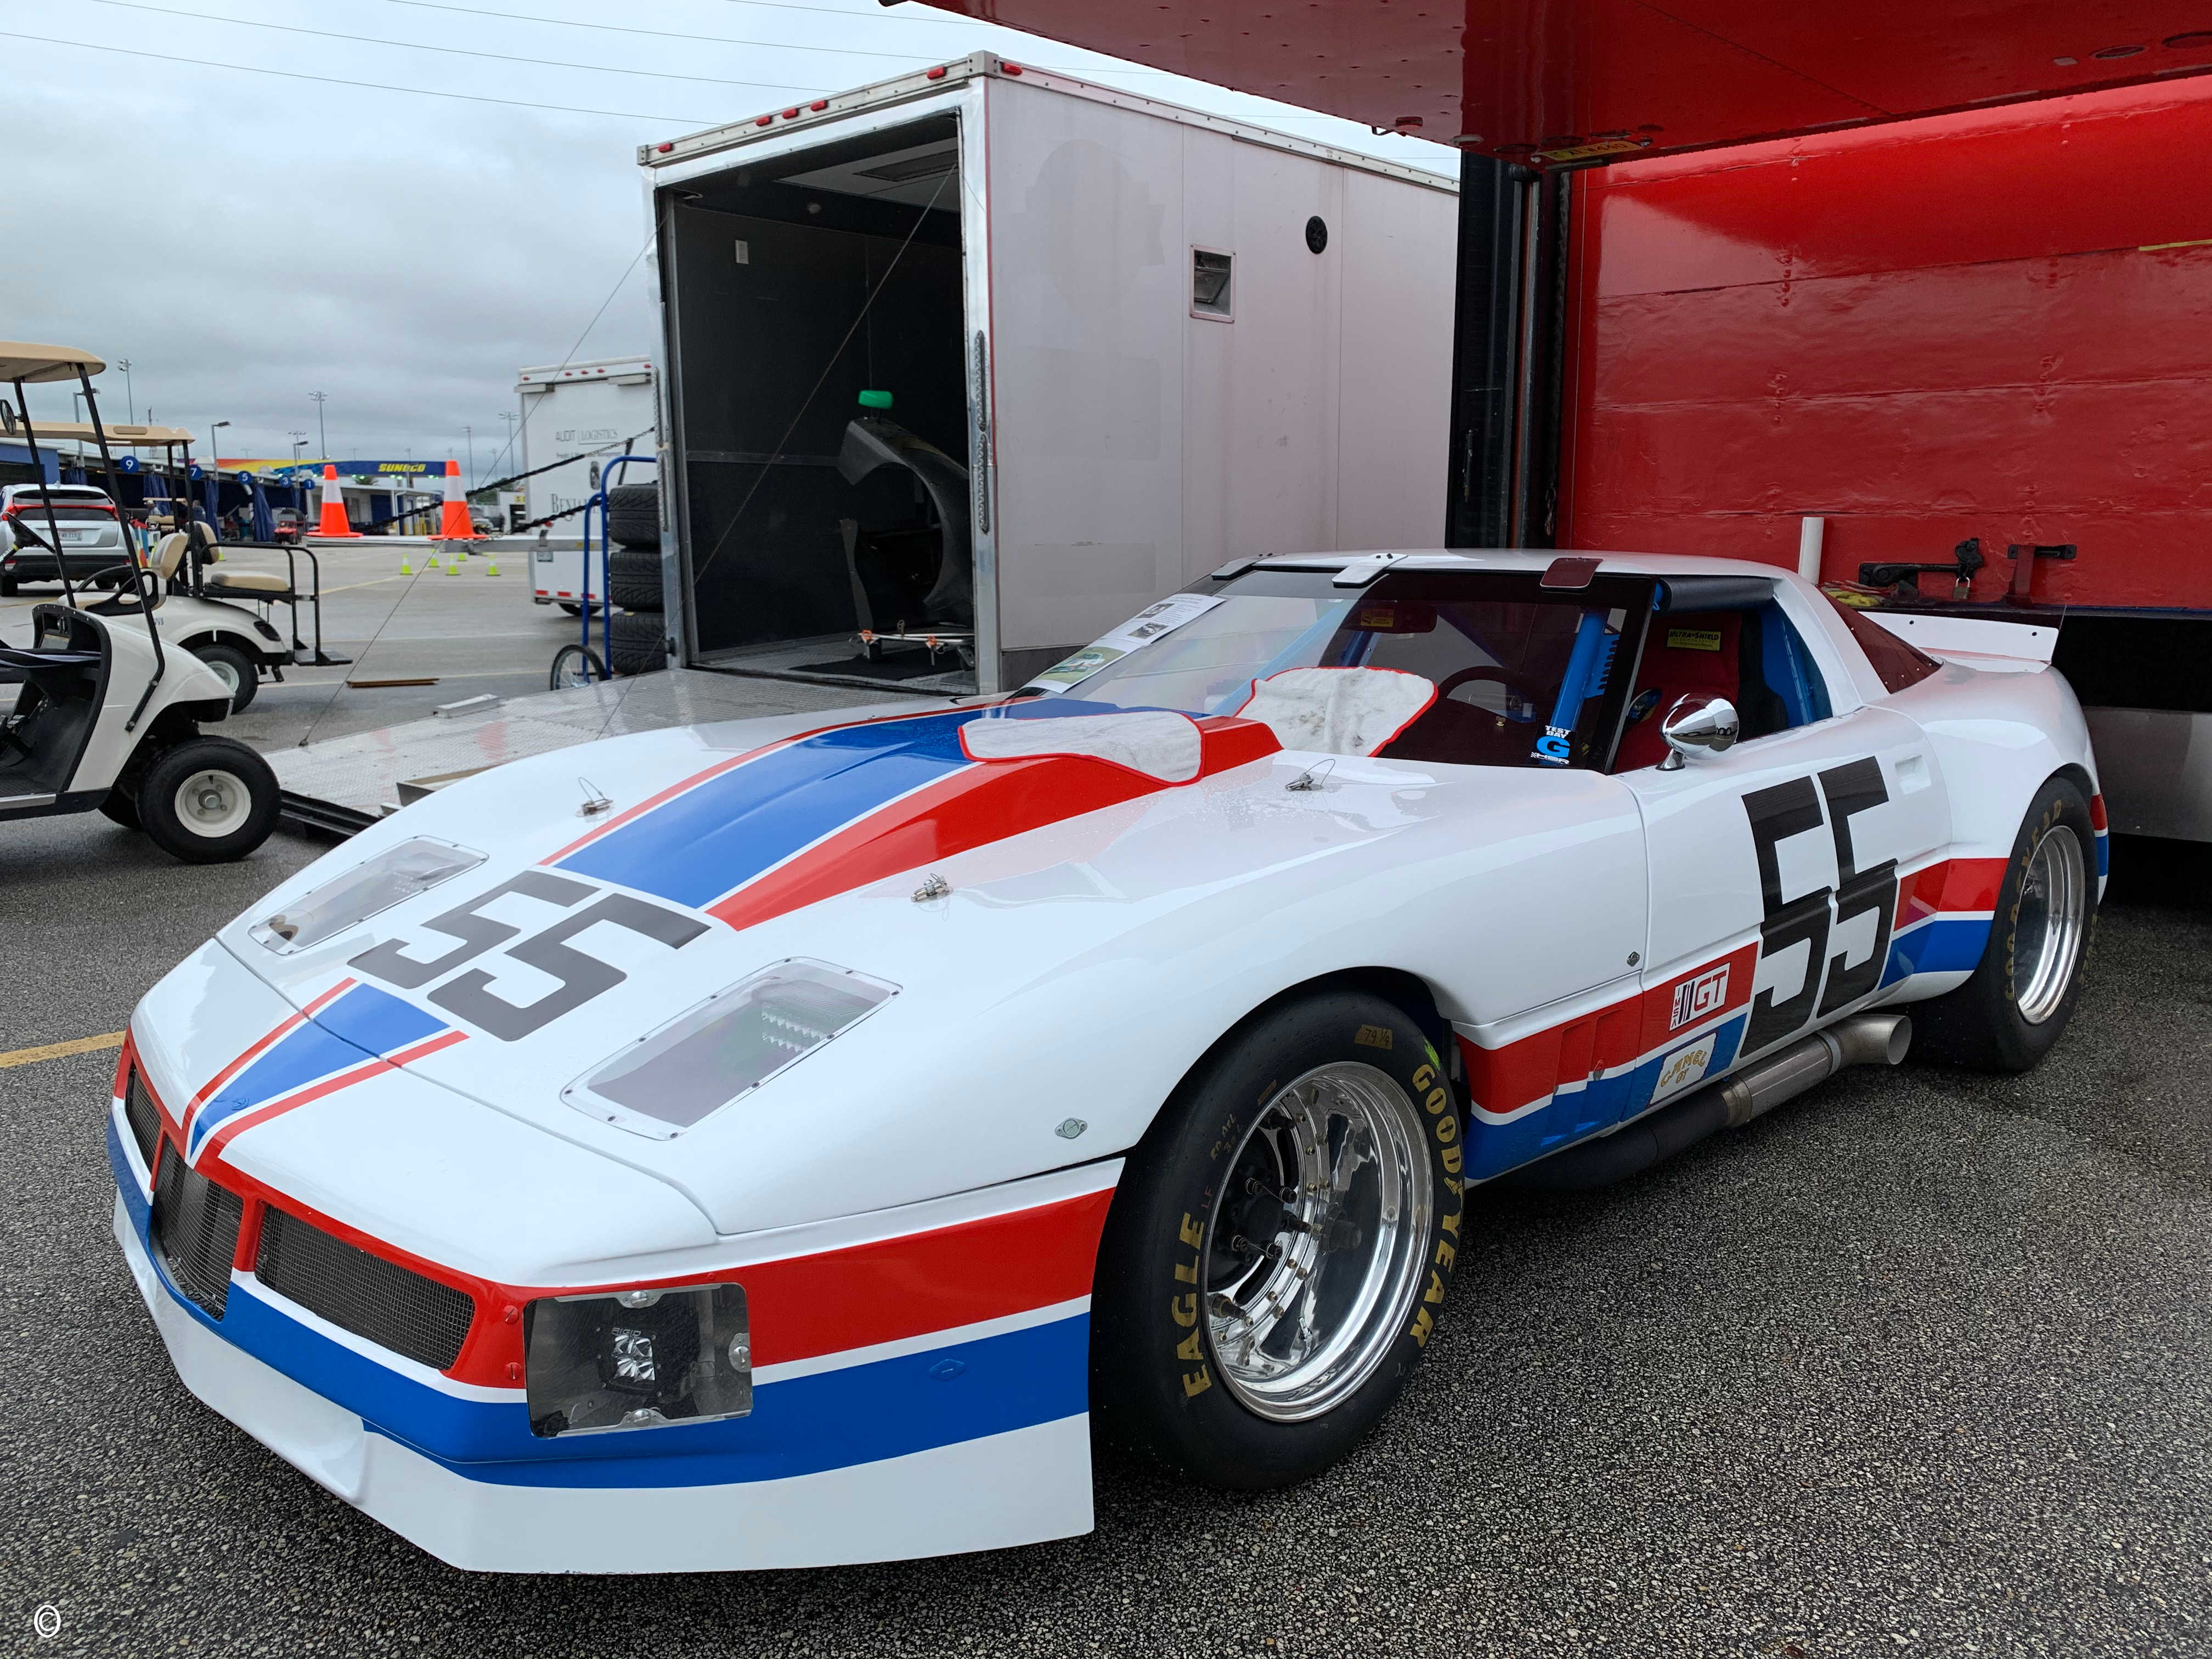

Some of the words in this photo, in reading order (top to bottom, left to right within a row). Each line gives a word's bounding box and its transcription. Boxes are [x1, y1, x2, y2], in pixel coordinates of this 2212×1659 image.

[582, 429, 619, 441] LOGISTICS
[126, 460, 133, 472] 9
[378, 464, 426, 472] SUNOCO
[242, 472, 248, 482] 5
[283, 477, 289, 486] 3
[1545, 725, 1571, 735] TEST
[1547, 731, 1567, 739] DAY
[1537, 736, 1570, 758] G
[1740, 755, 1898, 1059] 55
[346, 870, 713, 1042] 55
[1694, 969, 1727, 1012] GT
[1660, 1049, 1708, 1088] CAMEL
[1675, 1068, 1690, 1085] GT
[1171, 1211, 1212, 1398] EAGLE
[611, 1327, 641, 1337] RIGID
